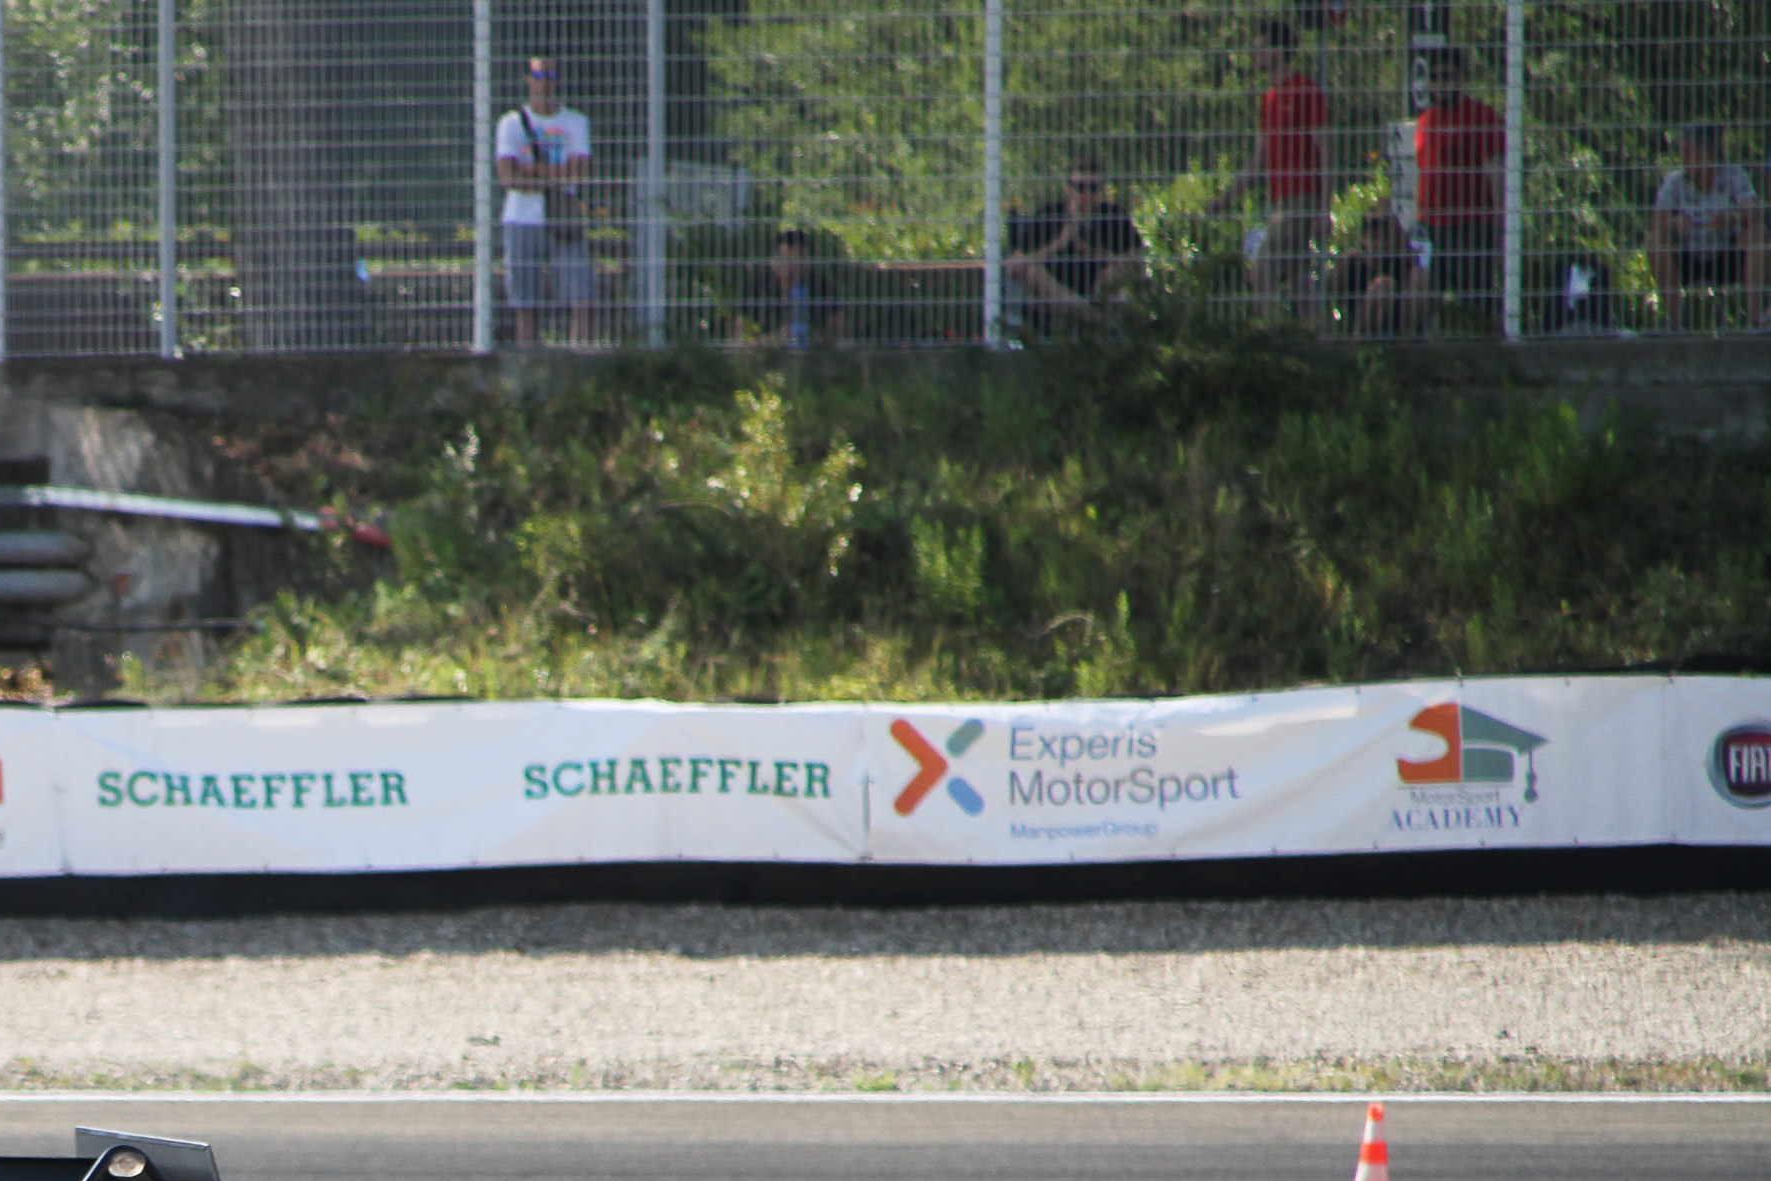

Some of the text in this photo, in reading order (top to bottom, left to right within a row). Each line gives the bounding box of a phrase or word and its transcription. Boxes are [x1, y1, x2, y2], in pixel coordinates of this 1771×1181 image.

[1009, 723, 1157, 768] Experis
[98, 771, 409, 808] SCHAEFFLER
[524, 757, 831, 800] SCHAEFFLER
[1009, 765, 1240, 811] MotorSport
[1388, 805, 1523, 831] ACADEMY
